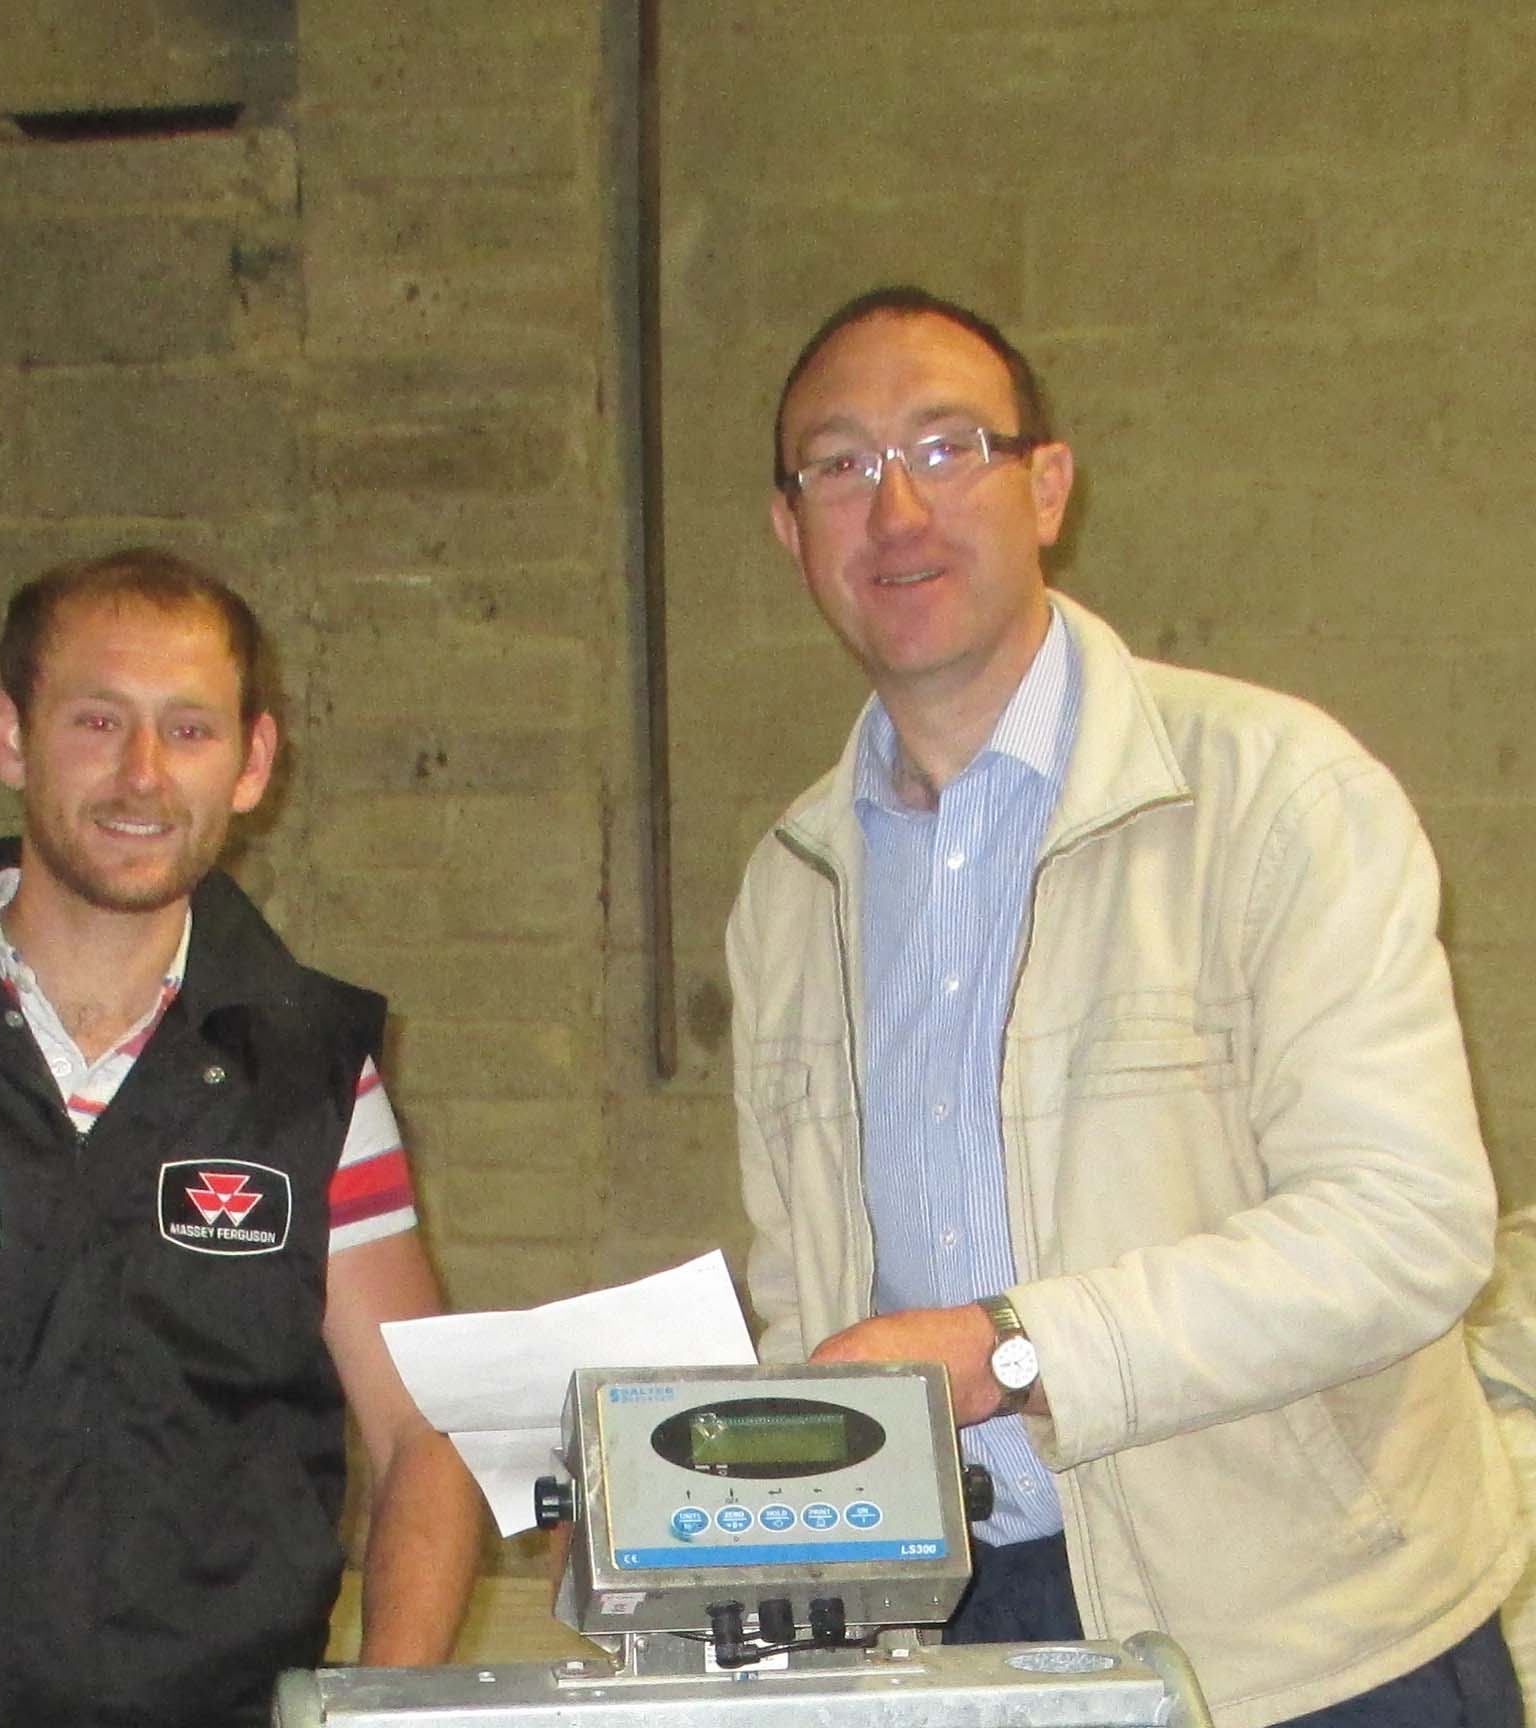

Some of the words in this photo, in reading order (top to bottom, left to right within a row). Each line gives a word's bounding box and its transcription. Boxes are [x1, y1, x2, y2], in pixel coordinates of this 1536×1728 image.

[170, 1222, 215, 1239] MASSEY
[217, 1227, 277, 1244] FERGUSON
[901, 1543, 937, 1555] LS300
